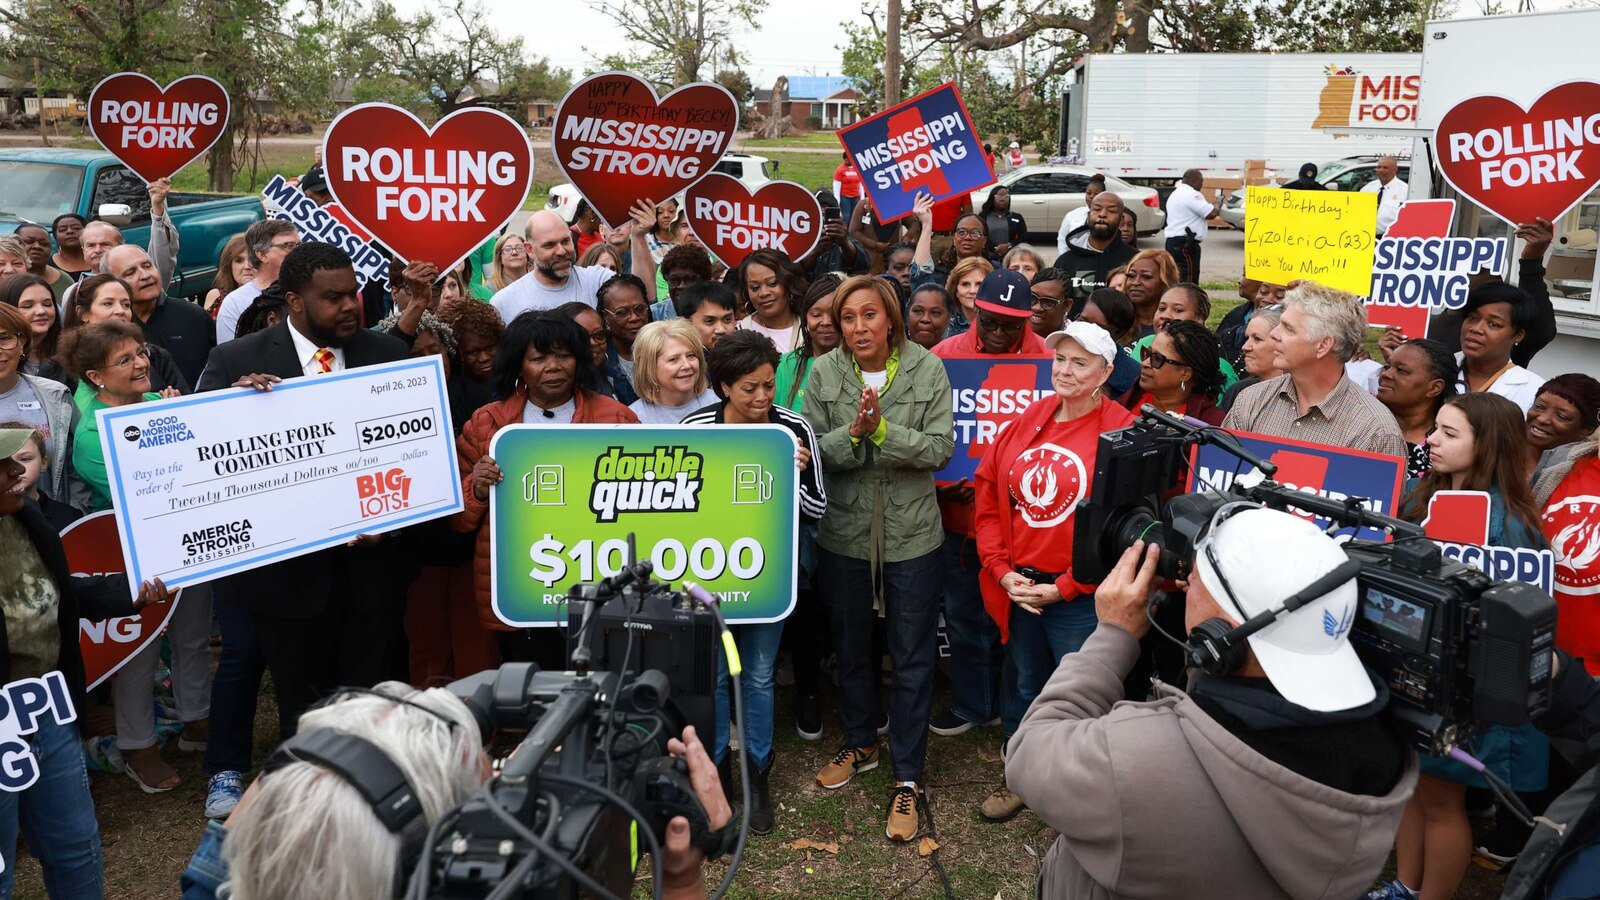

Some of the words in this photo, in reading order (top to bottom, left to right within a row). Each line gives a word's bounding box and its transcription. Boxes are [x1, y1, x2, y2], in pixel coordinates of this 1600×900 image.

[588, 80, 632, 97] HAPPY
[101, 100, 218, 125] ROLLING
[617, 102, 681, 122] BIRTHDAY
[1358, 104, 1417, 121] FOO
[121, 126, 197, 149] FORK
[562, 115, 725, 154] MISSISSIPPI
[855, 111, 965, 171] MISSISSIPPI
[1449, 113, 1600, 162] ROLLING
[341, 146, 516, 186] ROLLING
[567, 146, 700, 179] STRONG
[874, 140, 967, 189] STRONG
[1480, 150, 1585, 190] FORK
[376, 186, 486, 222] FORK
[1248, 188, 1278, 208] Happy
[695, 197, 811, 234] ROLLING
[264, 176, 391, 290] MISSISSIPP
[716, 224, 790, 255] FORK
[1249, 253, 1271, 268] Love
[1278, 257, 1293, 272] You
[1374, 240, 1506, 275] SISSIPPI
[1000, 285, 1015, 301] J
[1364, 274, 1468, 307] TRONG
[370, 383, 391, 395] April
[392, 381, 405, 390] 26,
[407, 376, 427, 388] 2023
[142, 423, 187, 437] MORNING
[148, 416, 178, 427] GOOD
[362, 416, 432, 444] $20,000
[138, 430, 195, 449] AMERICA
[197, 431, 281, 462] ROLLING
[285, 421, 336, 445] FORK
[401, 448, 428, 461] Dollars
[132, 470, 153, 481] Pay
[156, 467, 165, 476] to
[168, 461, 183, 474] the
[214, 440, 326, 476] COMMUNITY
[597, 448, 700, 480] double
[136, 483, 161, 496] order
[164, 478, 175, 493] of
[168, 491, 221, 510] Twenty
[225, 474, 290, 498] Thousand
[294, 465, 338, 482] Dollars
[356, 468, 406, 499] BIG
[360, 477, 412, 518] LOTS!
[593, 470, 699, 519] quick
[182, 519, 252, 545] AMERICA
[187, 531, 250, 556] STRONG
[183, 542, 255, 566] MISSISSIPPI
[529, 533, 765, 588] $10000
